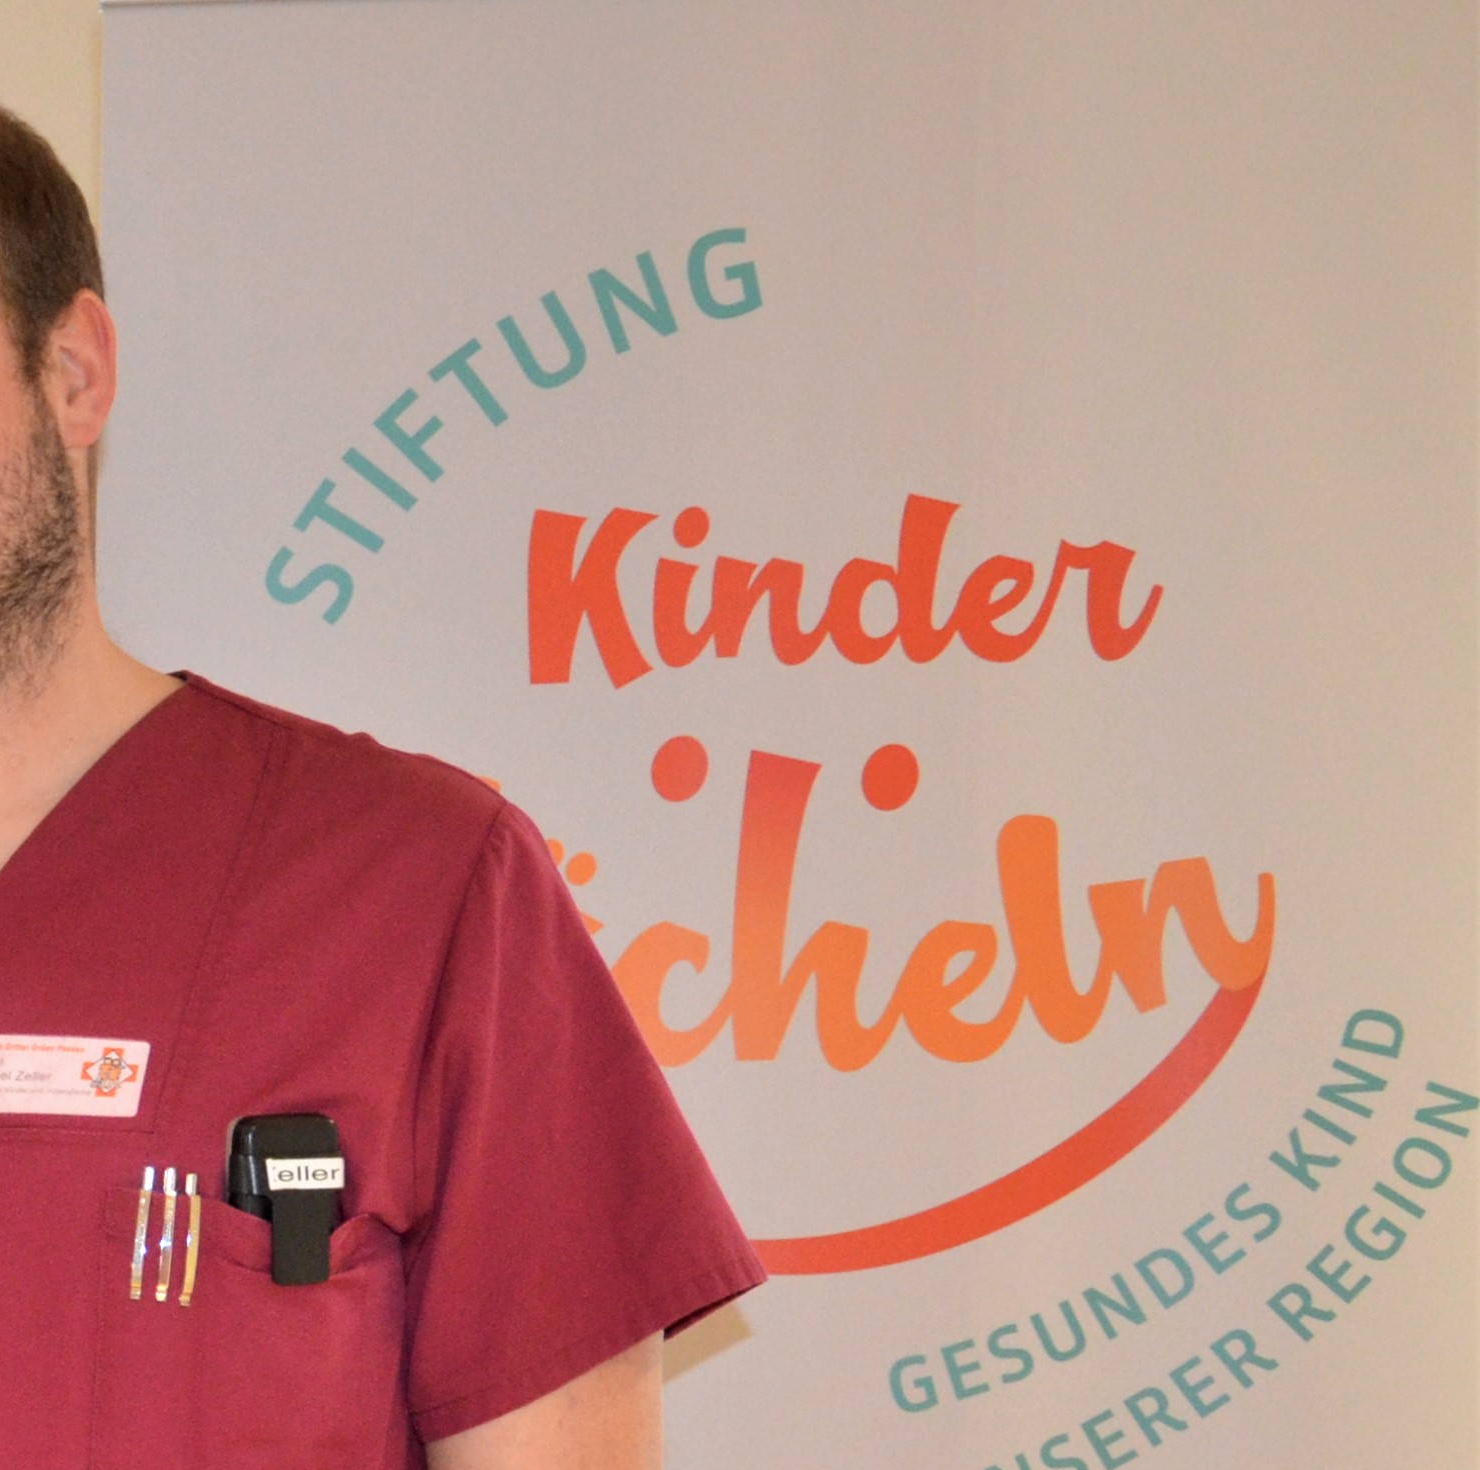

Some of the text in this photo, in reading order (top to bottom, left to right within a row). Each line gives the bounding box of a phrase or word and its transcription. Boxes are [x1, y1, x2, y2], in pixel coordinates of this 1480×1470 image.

[265, 227, 764, 625] STIFTUNG
[526, 493, 1165, 690] Kinder
[477, 748, 1276, 1073] cheln
[272, 1165, 341, 1183] eller
[888, 1008, 1405, 1414] GESUNDES KIND
[1265, 1080, 1480, 1344] REGION
